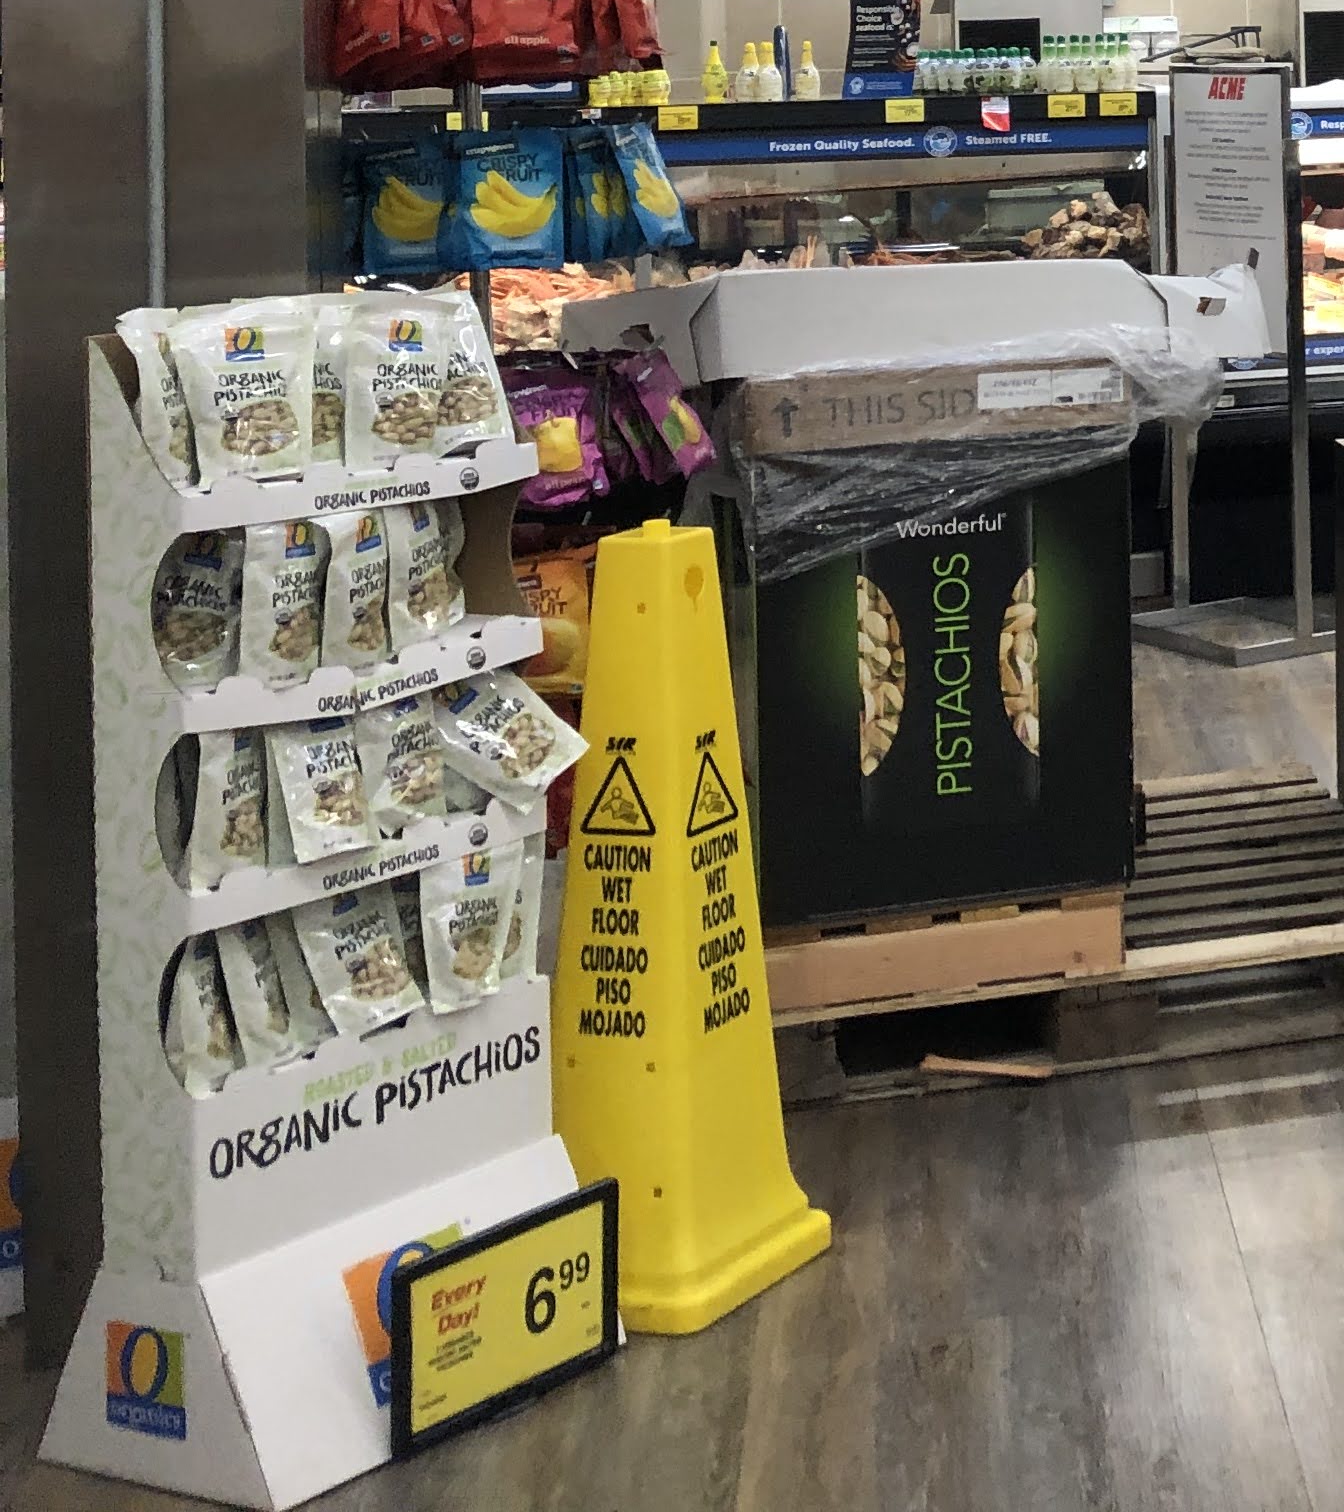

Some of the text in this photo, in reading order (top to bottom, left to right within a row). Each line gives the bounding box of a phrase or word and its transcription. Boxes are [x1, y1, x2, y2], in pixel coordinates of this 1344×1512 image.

[1208, 76, 1246, 101] ACME
[769, 132, 1052, 152] Frozen Quality Seafood. Steamed FREE.
[477, 154, 538, 172] CRISPY
[827, 392, 907, 428] THIS
[916, 389, 977, 420] SID
[896, 513, 1003, 540] Wonderful
[932, 553, 973, 796] PISTACHIOS
[584, 843, 651, 872] CAUTION
[691, 829, 739, 872] CAUTION
[601, 876, 633, 903] WET
[705, 864, 727, 896] WET
[592, 907, 640, 936] FLOOR
[702, 893, 736, 931] FLOOR
[580, 946, 648, 974] CUIDADO
[699, 926, 745, 971] CUIDADO
[595, 977, 631, 1005] PISO
[711, 963, 737, 996] PISO
[578, 1008, 646, 1038] MOJADO
[704, 987, 751, 1034] MOJADO
[431, 1274, 487, 1311] Every
[438, 1301, 481, 1337] Day!
